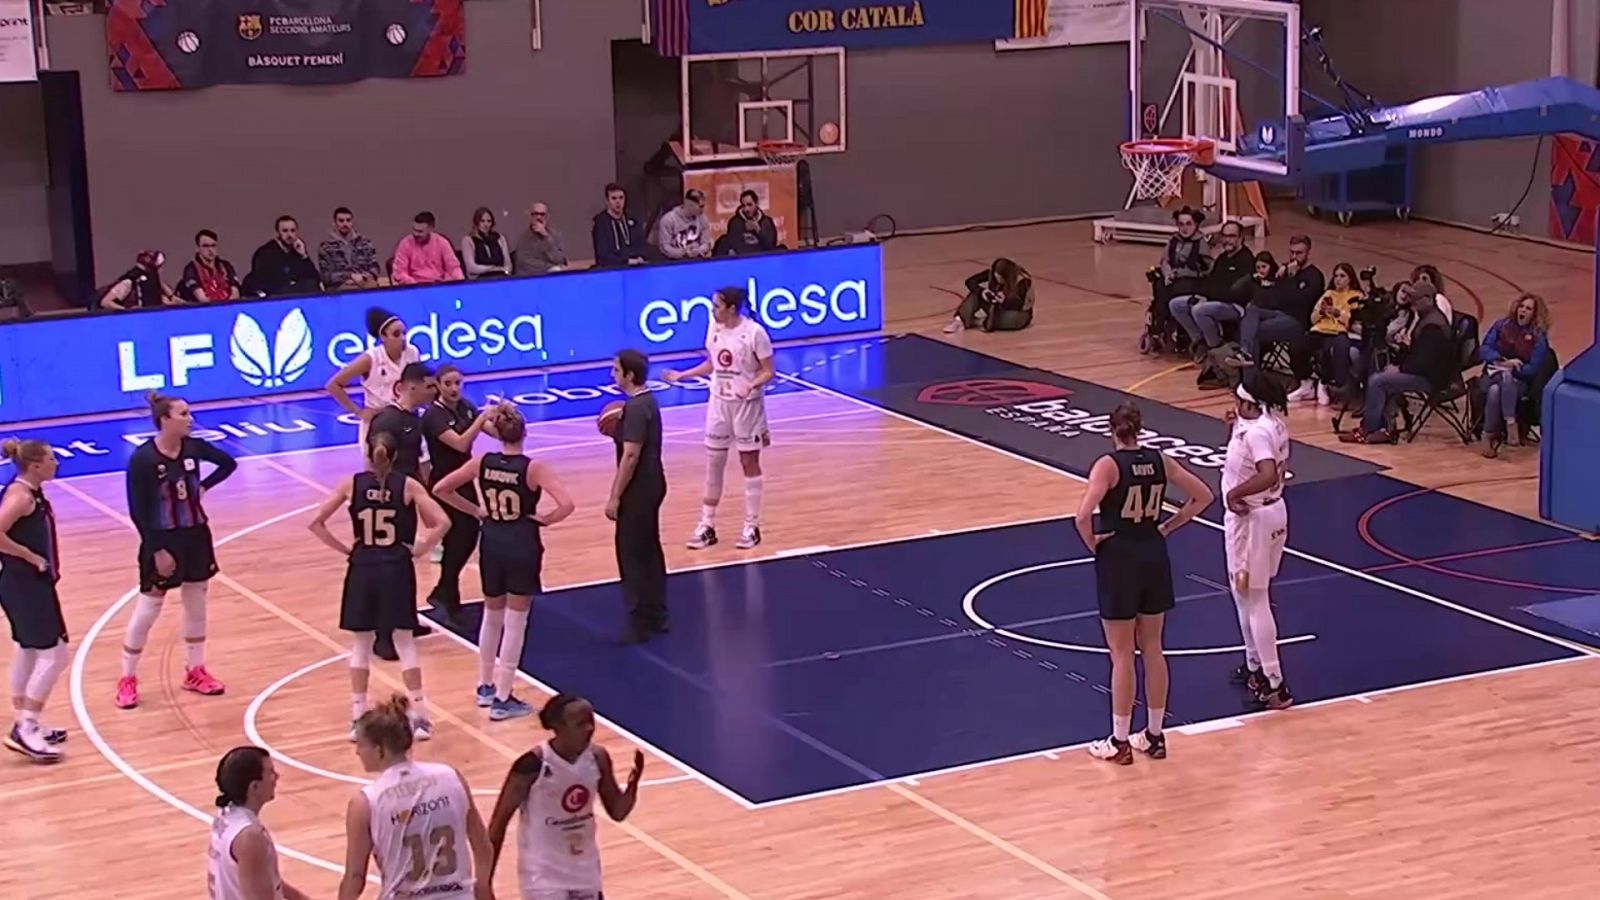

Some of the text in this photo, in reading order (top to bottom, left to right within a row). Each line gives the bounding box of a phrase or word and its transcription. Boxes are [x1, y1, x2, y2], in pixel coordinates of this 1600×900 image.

[269, 23, 352, 34] SECCIONS AMATEURS
[788, 1, 925, 33] COR CATALÀ
[248, 52, 344, 67] BÀSQUET FEMENÍ
[1408, 127, 1443, 139] MONDO
[118, 333, 215, 393] LF
[485, 488, 522, 521] 10
[1121, 483, 1164, 524] 44
[357, 507, 398, 547] 15
[402, 825, 458, 881] 13
